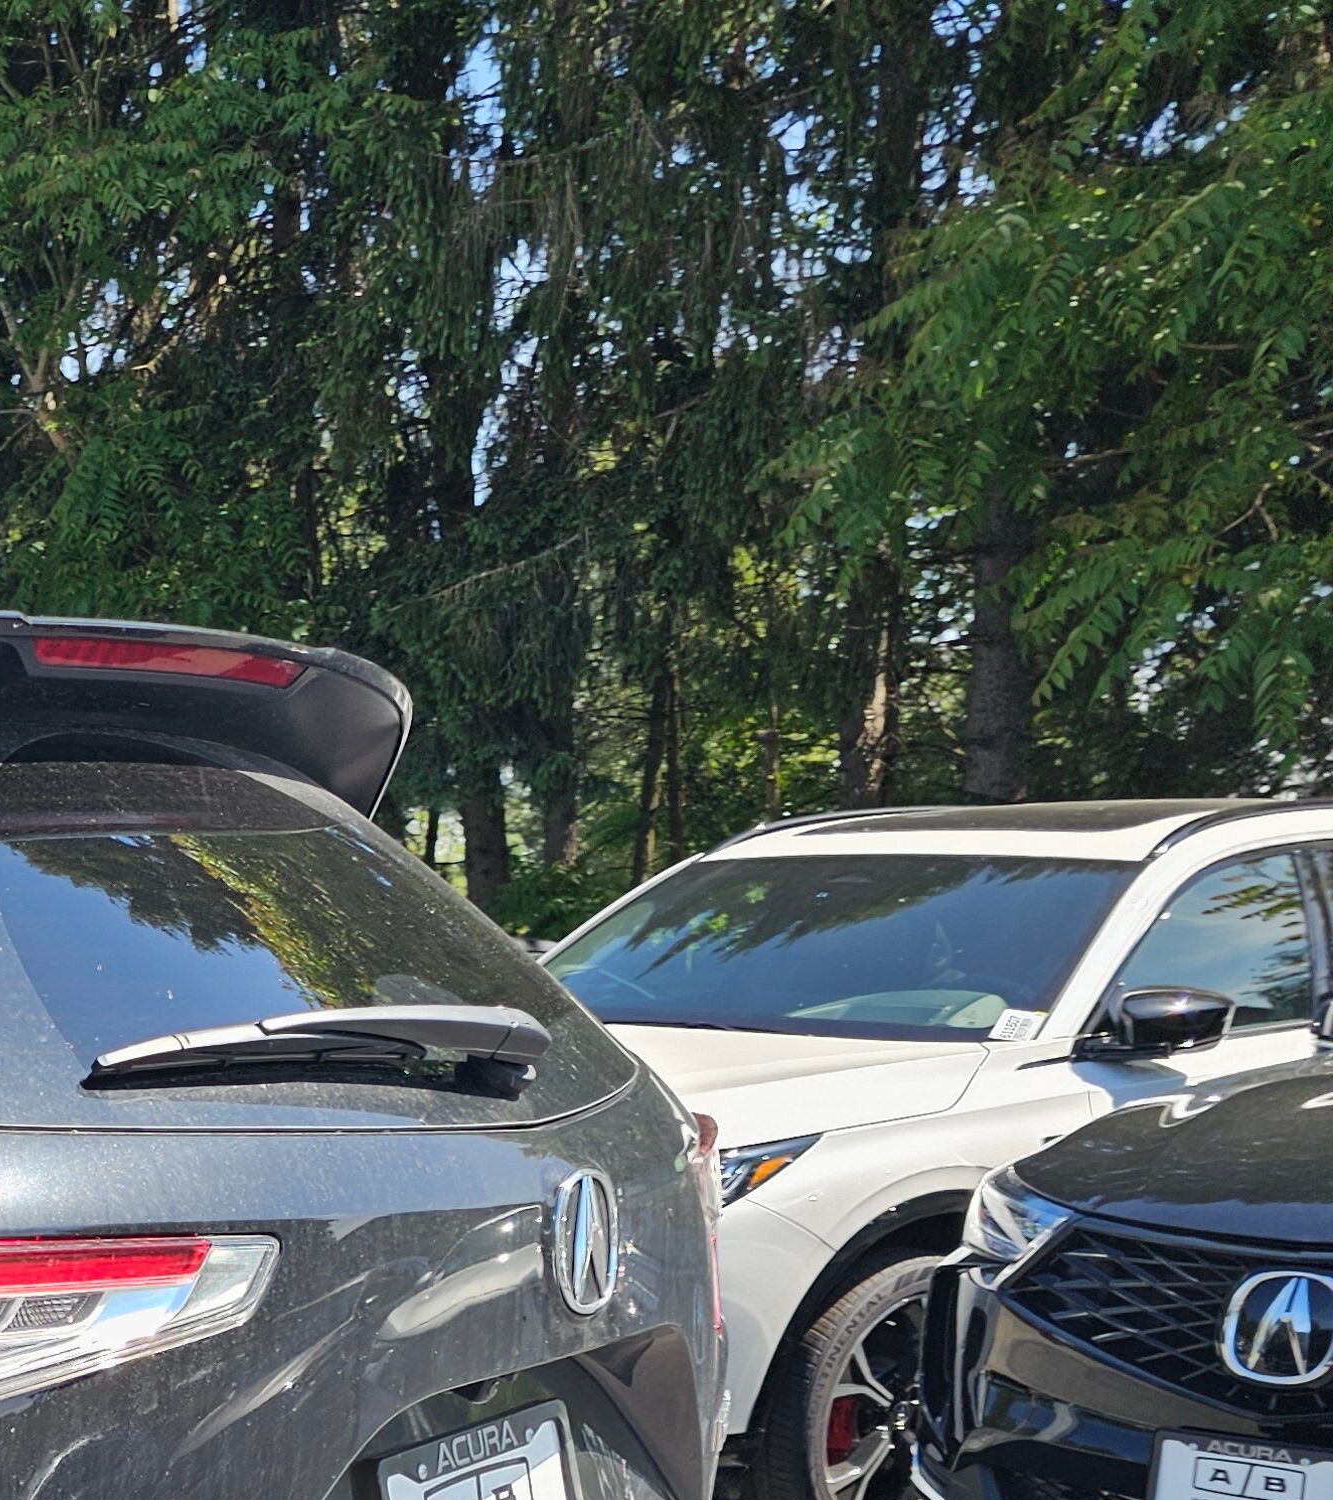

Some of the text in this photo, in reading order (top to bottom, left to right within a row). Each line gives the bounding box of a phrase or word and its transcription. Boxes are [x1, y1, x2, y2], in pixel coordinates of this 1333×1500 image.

[436, 1420, 517, 1475] ACURA
[1206, 1439, 1293, 1463] ACURA
[1209, 1468, 1286, 1493] A B
